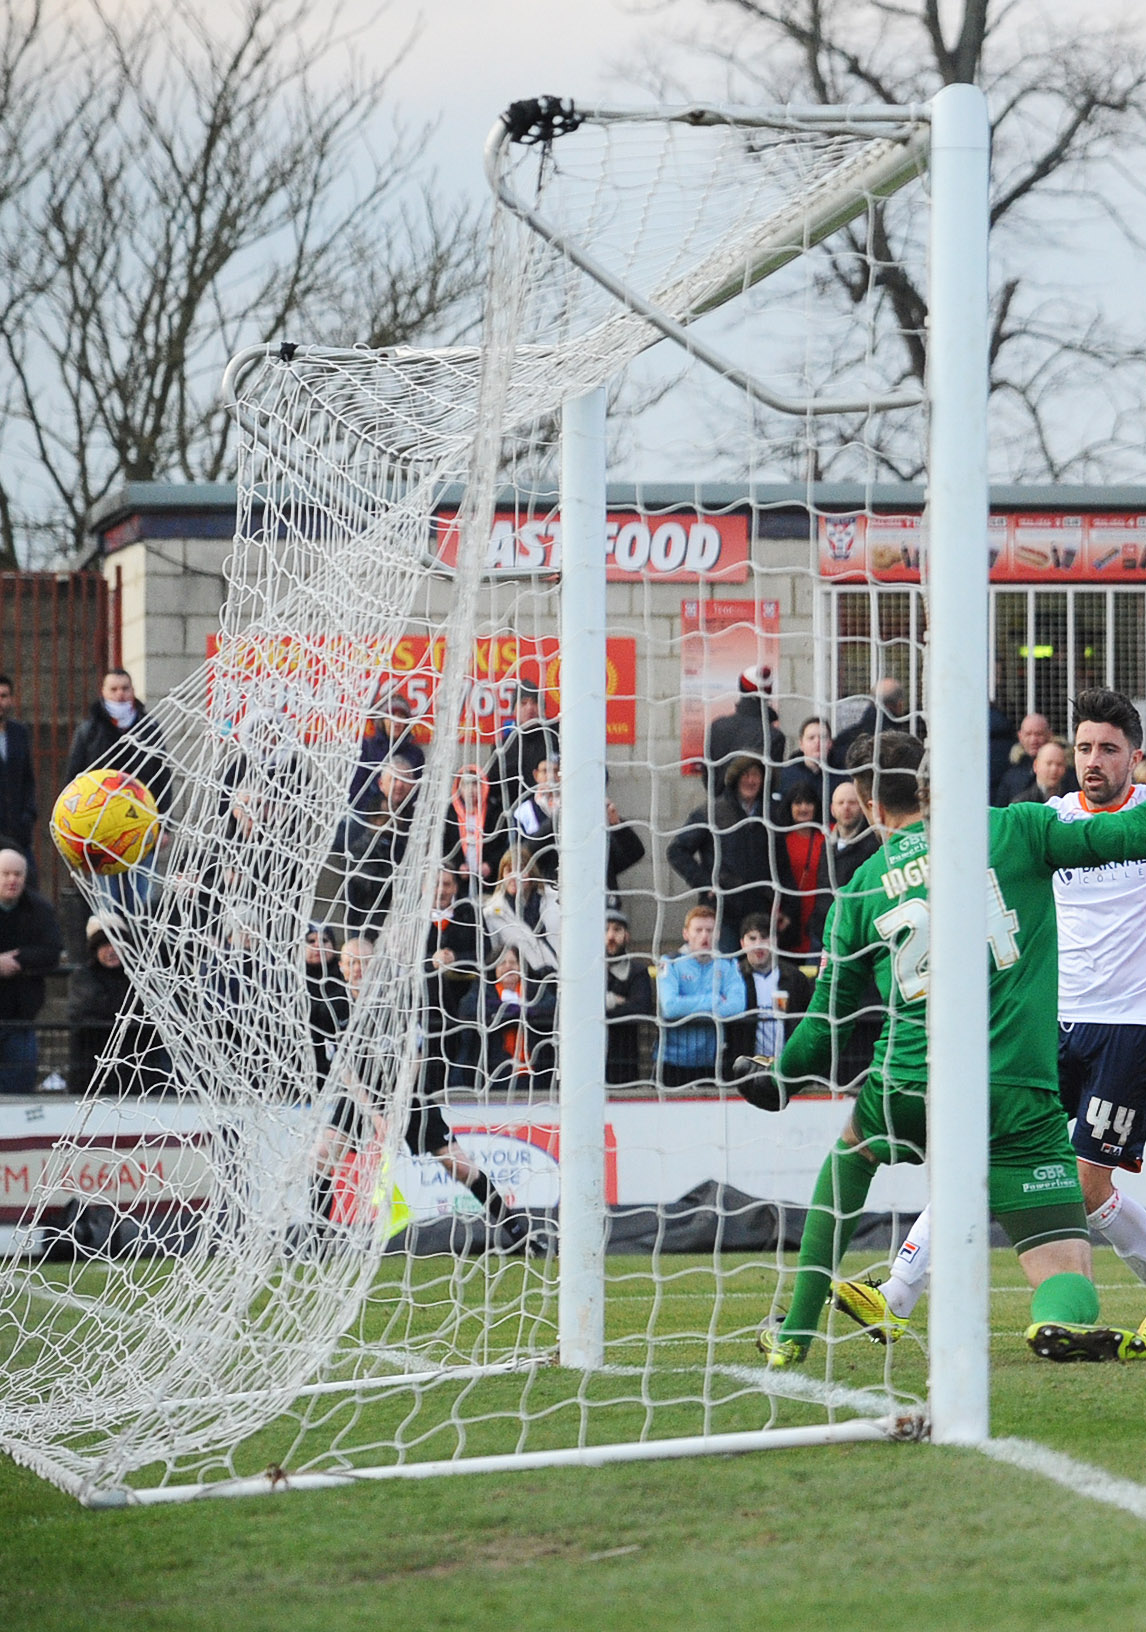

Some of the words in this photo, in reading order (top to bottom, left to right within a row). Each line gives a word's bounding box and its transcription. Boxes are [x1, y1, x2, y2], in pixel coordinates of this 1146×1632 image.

[478, 520, 562, 569] AST
[1086, 1096, 1136, 1146] 44
[481, 1150, 532, 1166] YOUR
[1033, 1164, 1067, 1181] GBR
